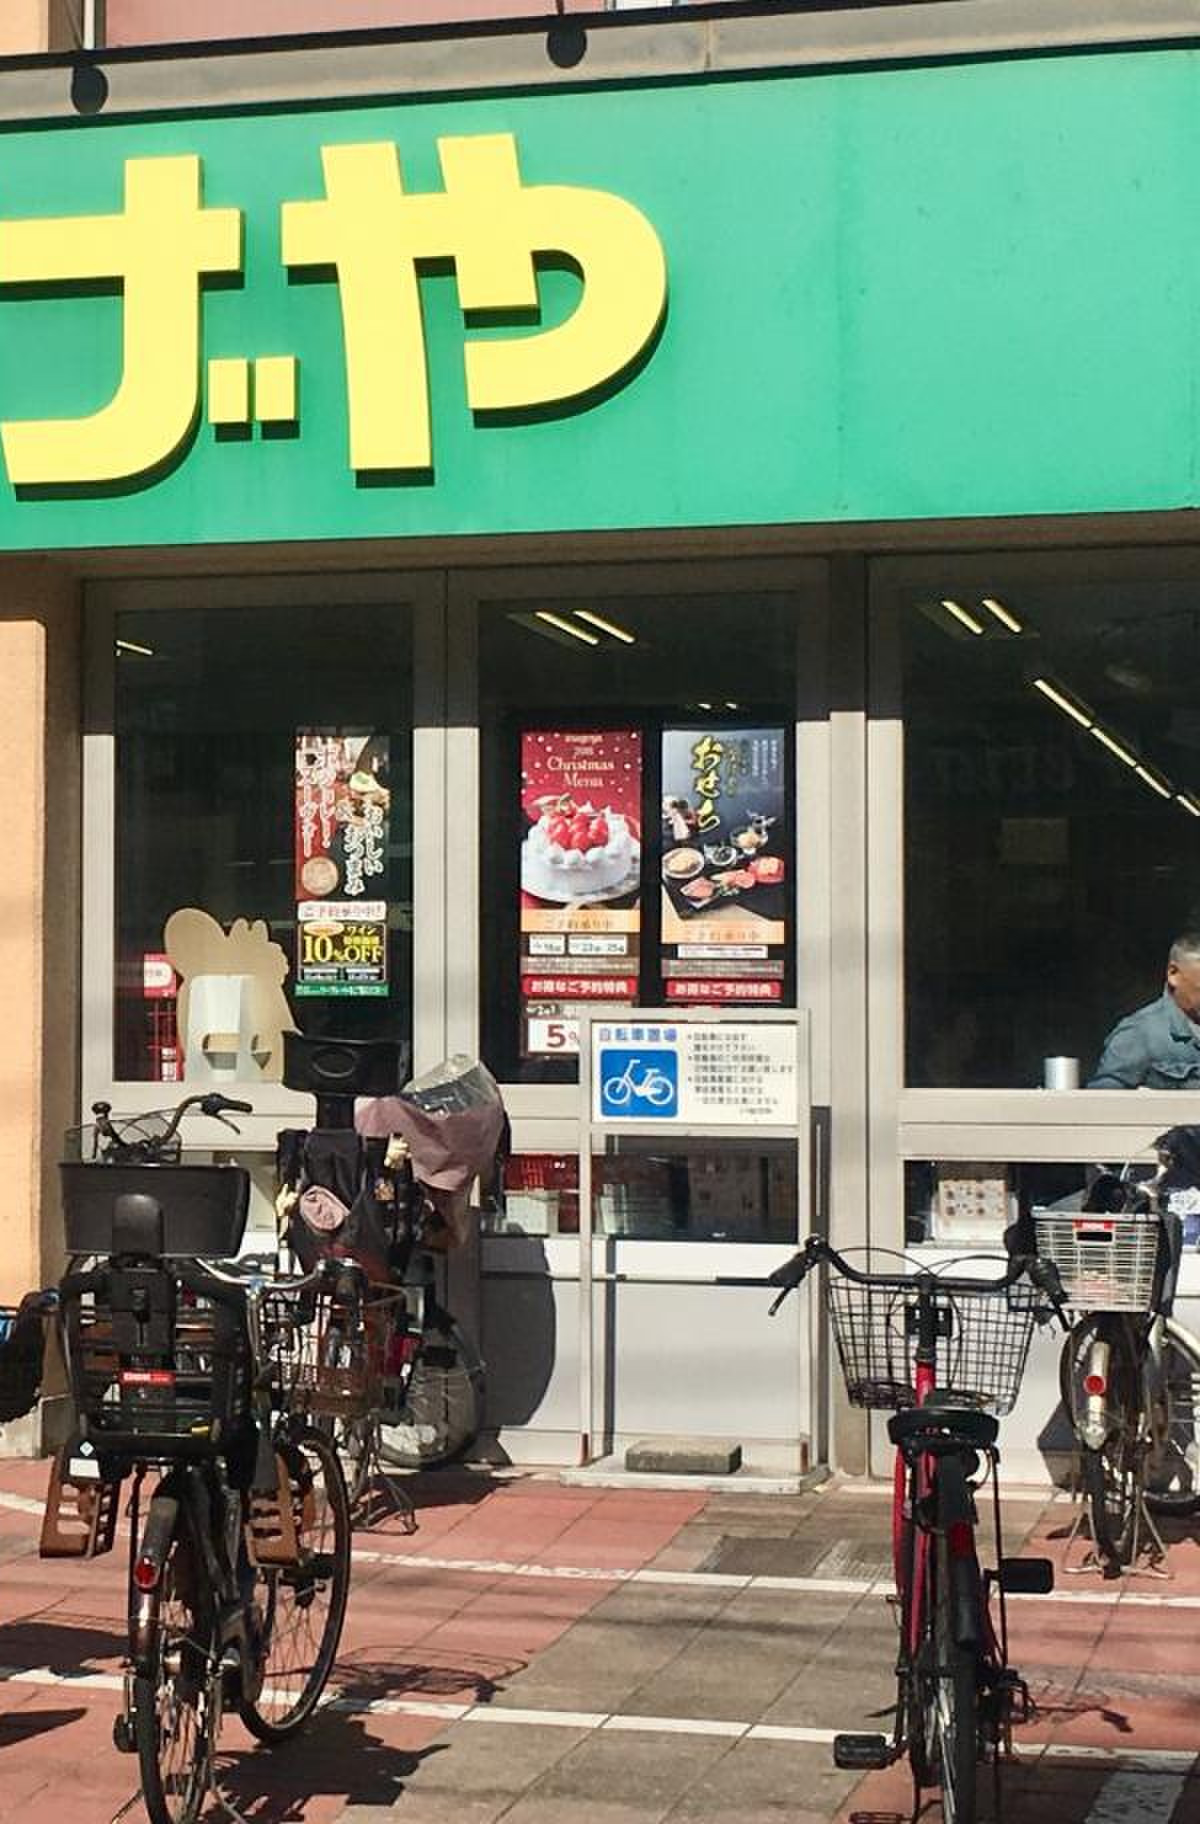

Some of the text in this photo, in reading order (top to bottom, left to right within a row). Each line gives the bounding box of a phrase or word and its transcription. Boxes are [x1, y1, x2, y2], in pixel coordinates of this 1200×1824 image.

[547, 756, 615, 770] Christmas
[564, 772, 604, 787] Menu
[692, 736, 722, 833] おせち
